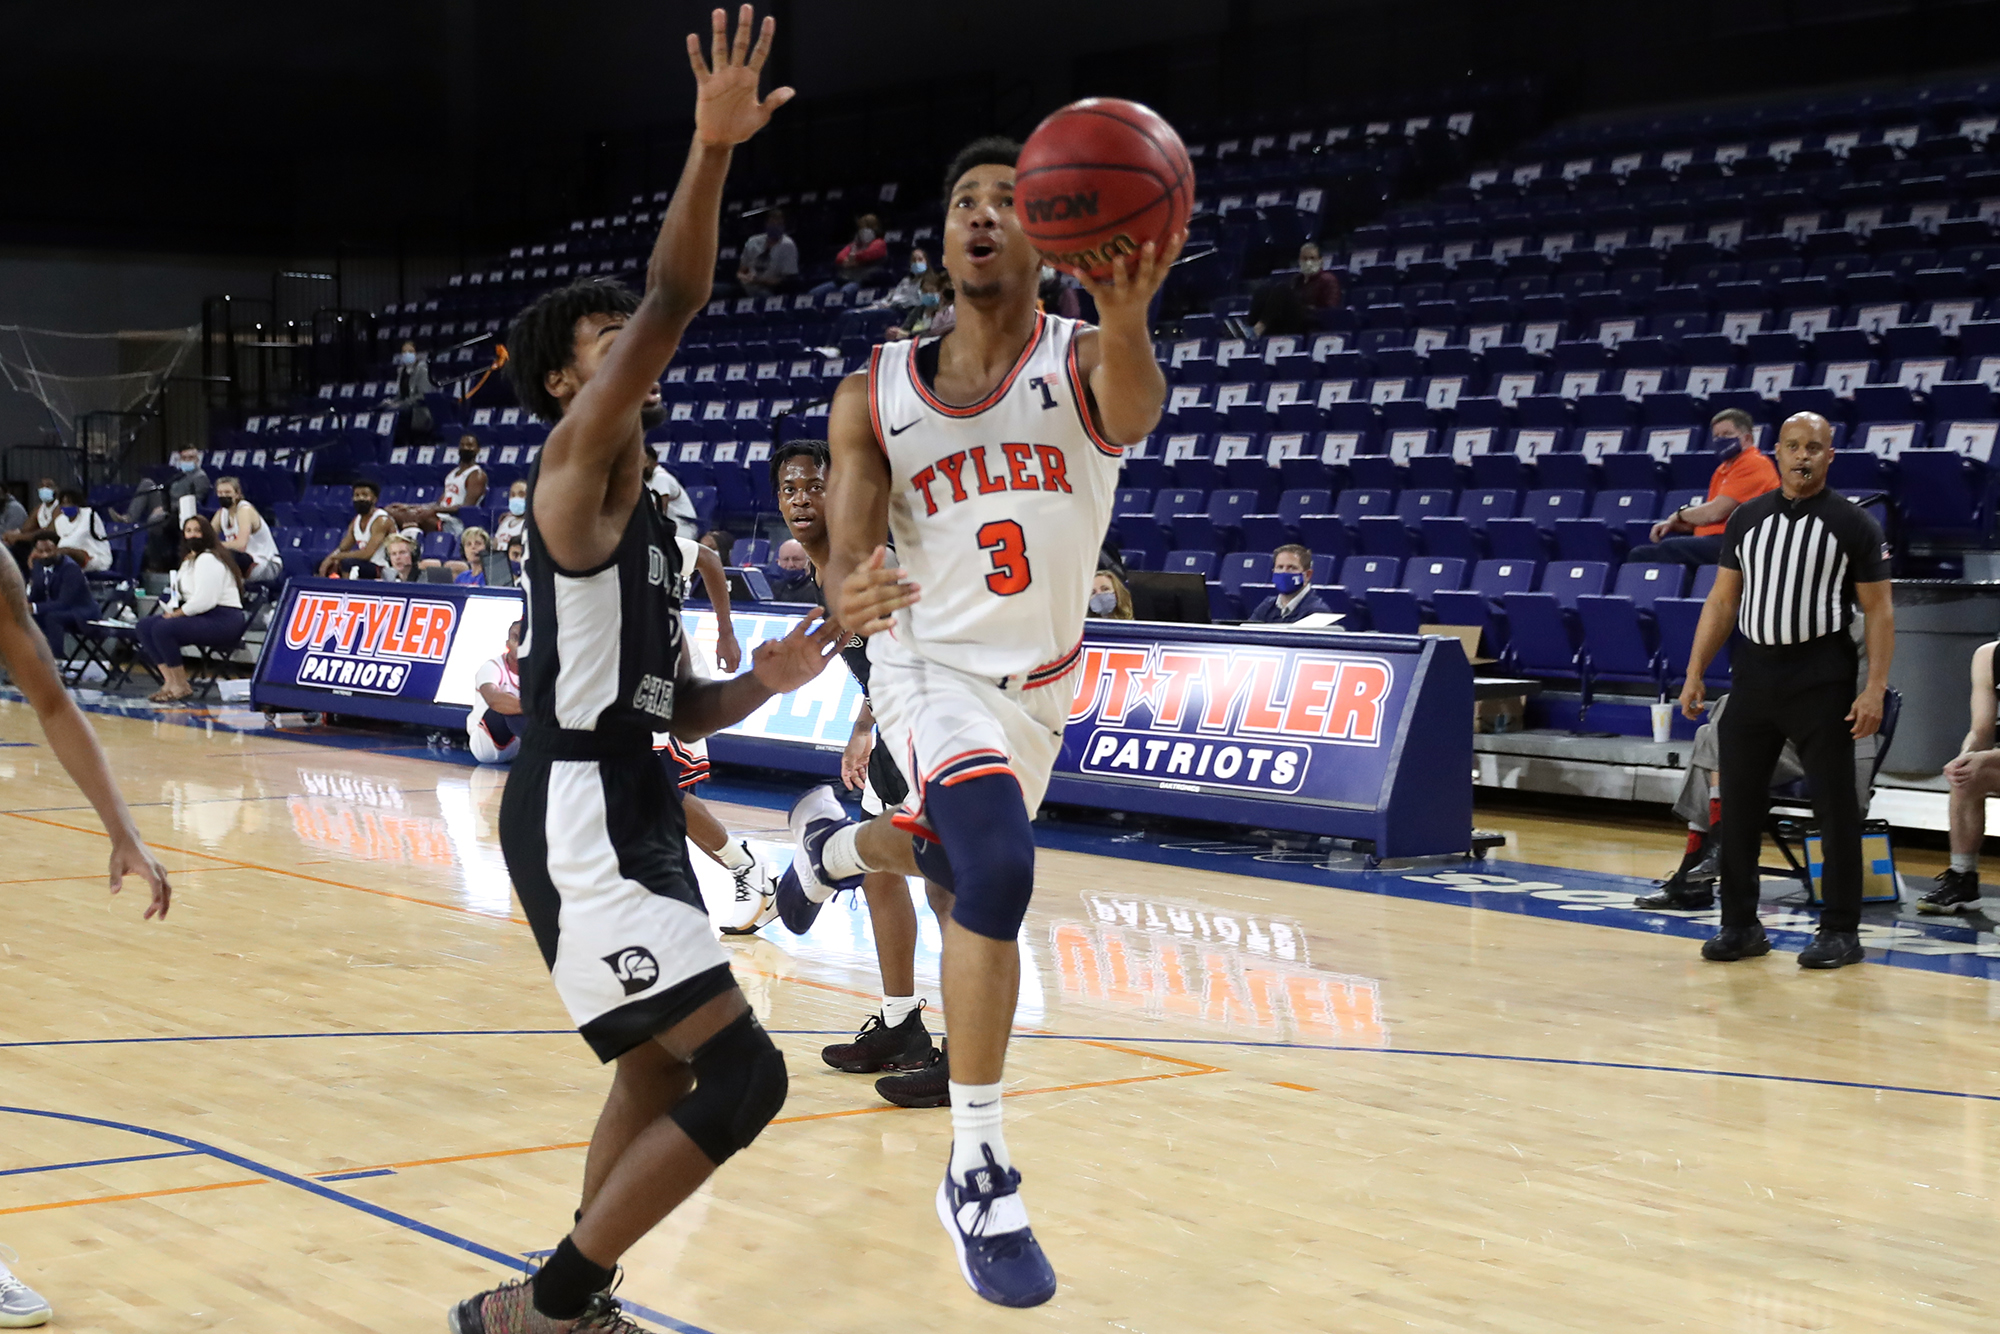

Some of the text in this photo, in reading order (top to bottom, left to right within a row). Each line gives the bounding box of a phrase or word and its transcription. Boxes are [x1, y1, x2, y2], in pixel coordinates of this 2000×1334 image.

[1029, 373, 1058, 410] T
[911, 443, 1073, 517] TYLER
[976, 519, 1032, 596] 3
[286, 591, 457, 664] UT TYLER
[302, 657, 404, 690] PATRIOTS
[1150, 646, 1395, 747] TYLER
[1090, 735, 1299, 785] PATRIOTS
